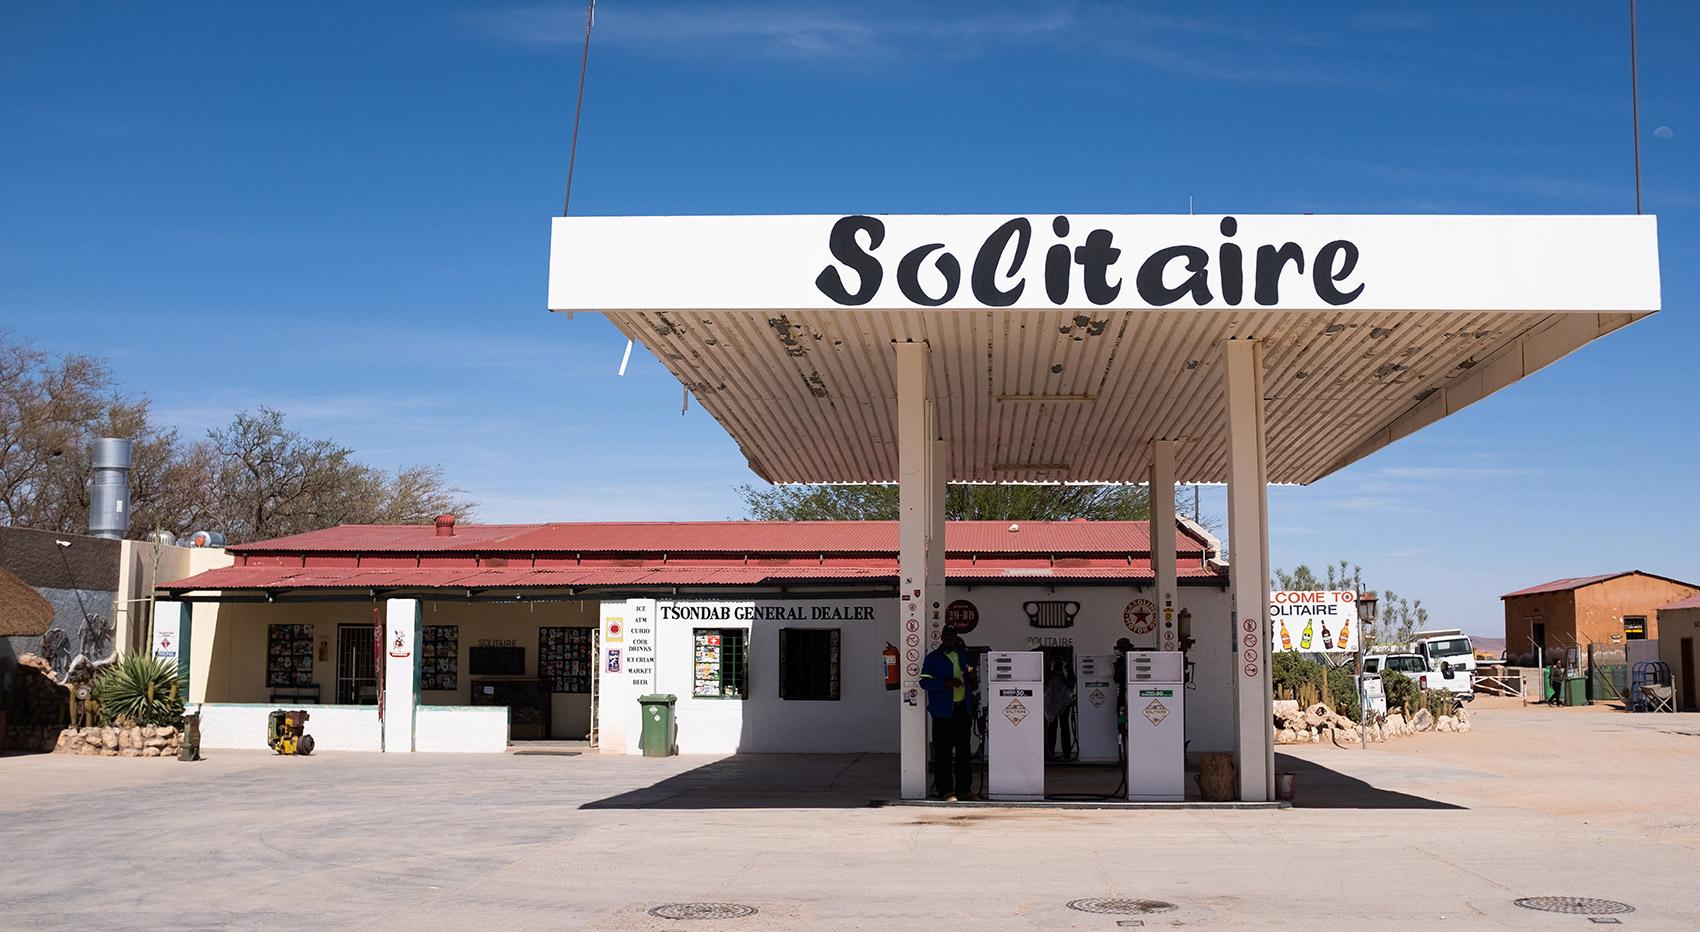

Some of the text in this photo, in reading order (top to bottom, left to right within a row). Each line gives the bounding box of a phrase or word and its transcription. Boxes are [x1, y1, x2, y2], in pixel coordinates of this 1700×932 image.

[815, 215, 1365, 306] Solitaire
[1270, 592, 1354, 604] COME TO
[660, 606, 875, 620] TSONDAB GENERAL DEALER
[1270, 604, 1338, 616] OLITAIRE
